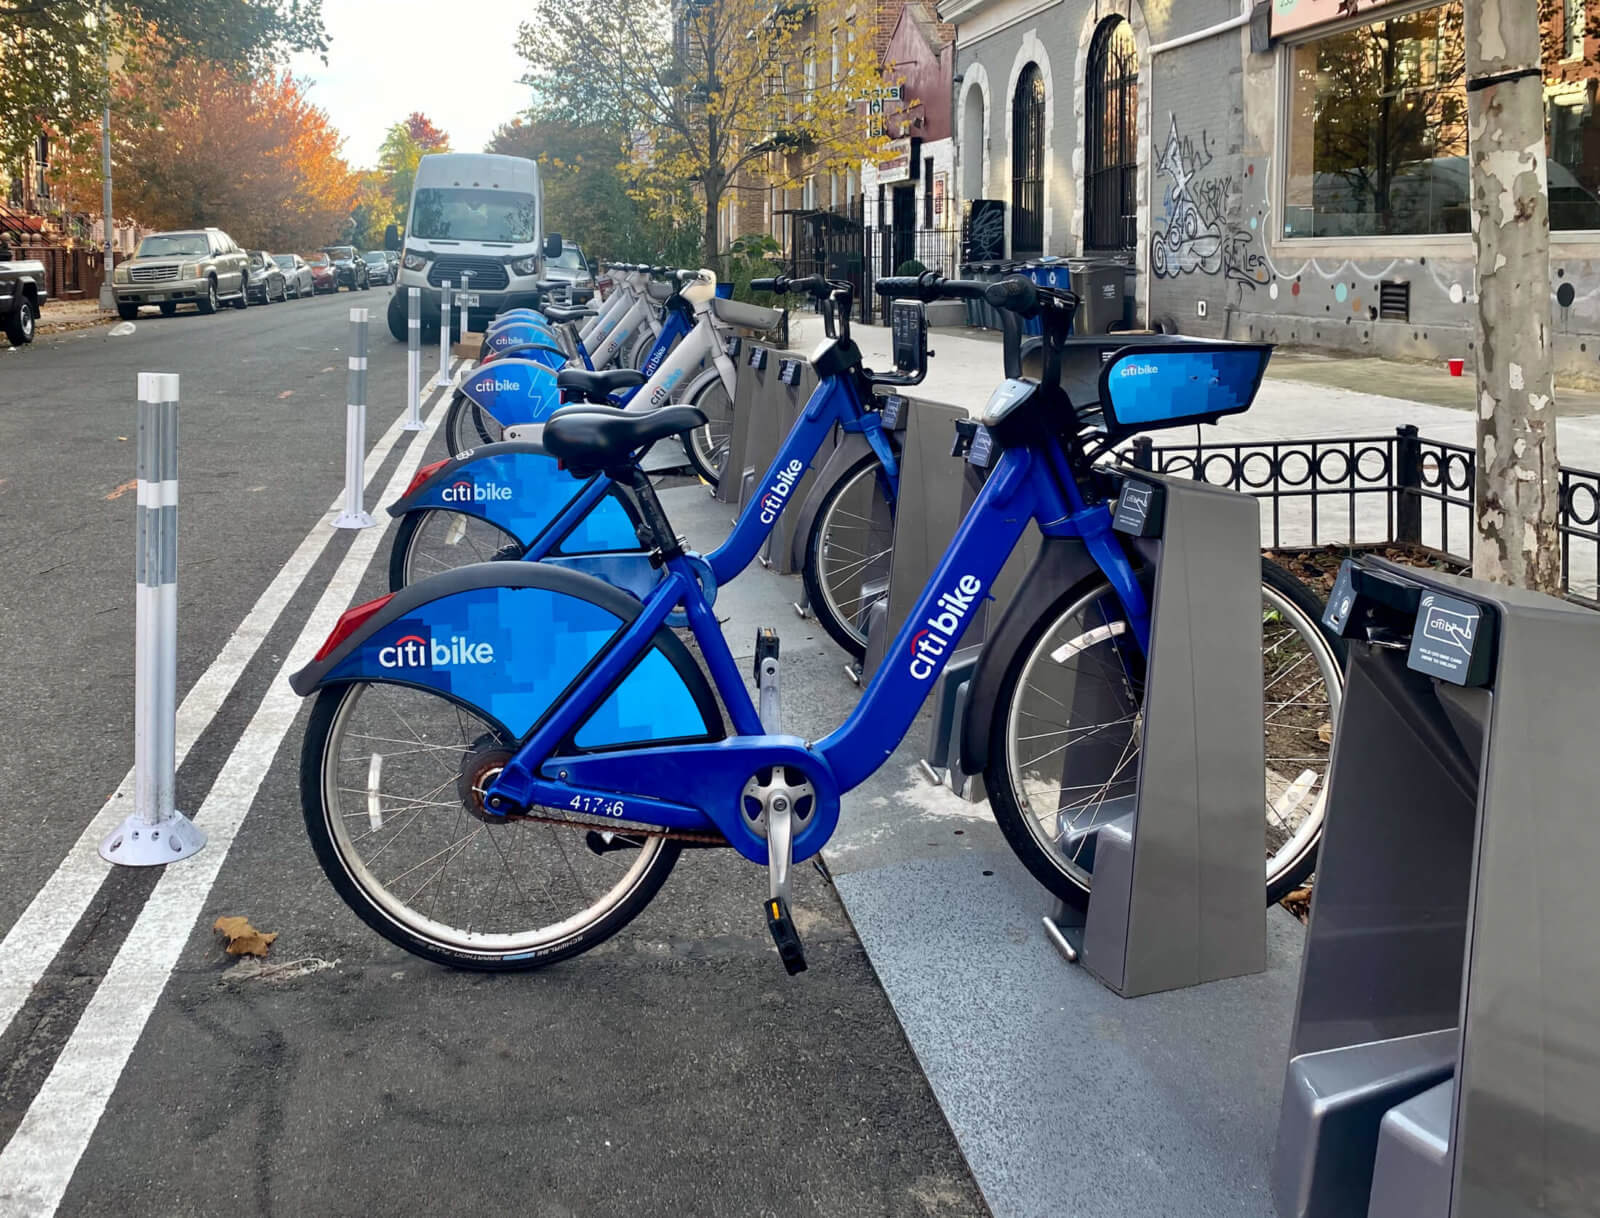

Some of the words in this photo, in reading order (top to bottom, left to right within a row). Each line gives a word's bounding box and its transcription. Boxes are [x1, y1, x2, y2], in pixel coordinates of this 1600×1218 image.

[475, 378, 494, 392] citi
[495, 379, 520, 391] bike
[1121, 364, 1137, 377] citi
[1137, 364, 1159, 375] bike
[442, 481, 471, 501] citi
[473, 482, 513, 501] bike
[770, 459, 803, 497] bike
[760, 493, 783, 524] citi
[927, 574, 981, 637] bike
[378, 635, 427, 668] citi
[430, 635, 495, 666] bike
[910, 629, 948, 680] citi
